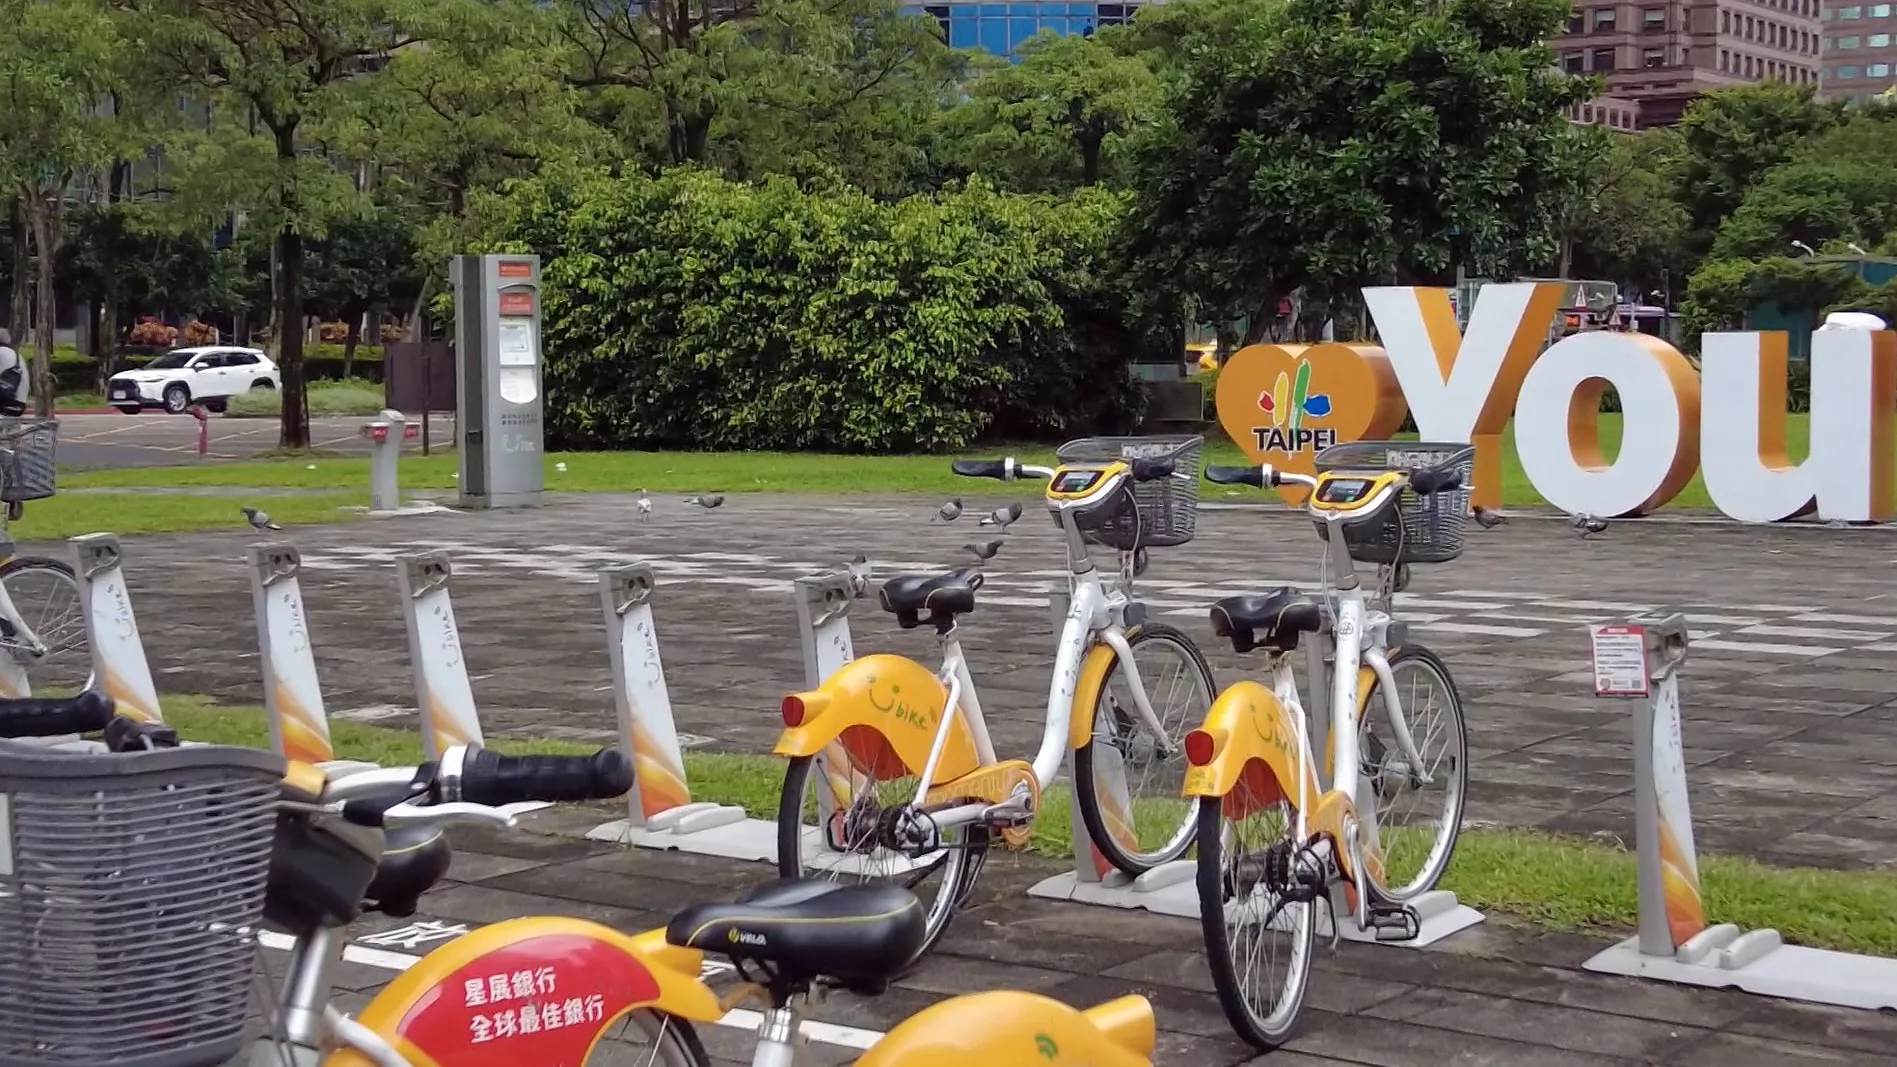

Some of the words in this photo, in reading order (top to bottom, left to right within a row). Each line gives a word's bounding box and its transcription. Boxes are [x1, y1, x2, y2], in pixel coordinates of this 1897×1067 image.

[1361, 283, 1895, 522] You
[1251, 427, 1338, 452] TAIPEI
[464, 965, 557, 1008] 星展銀行
[469, 993, 605, 1044] 全球最佳銀行
